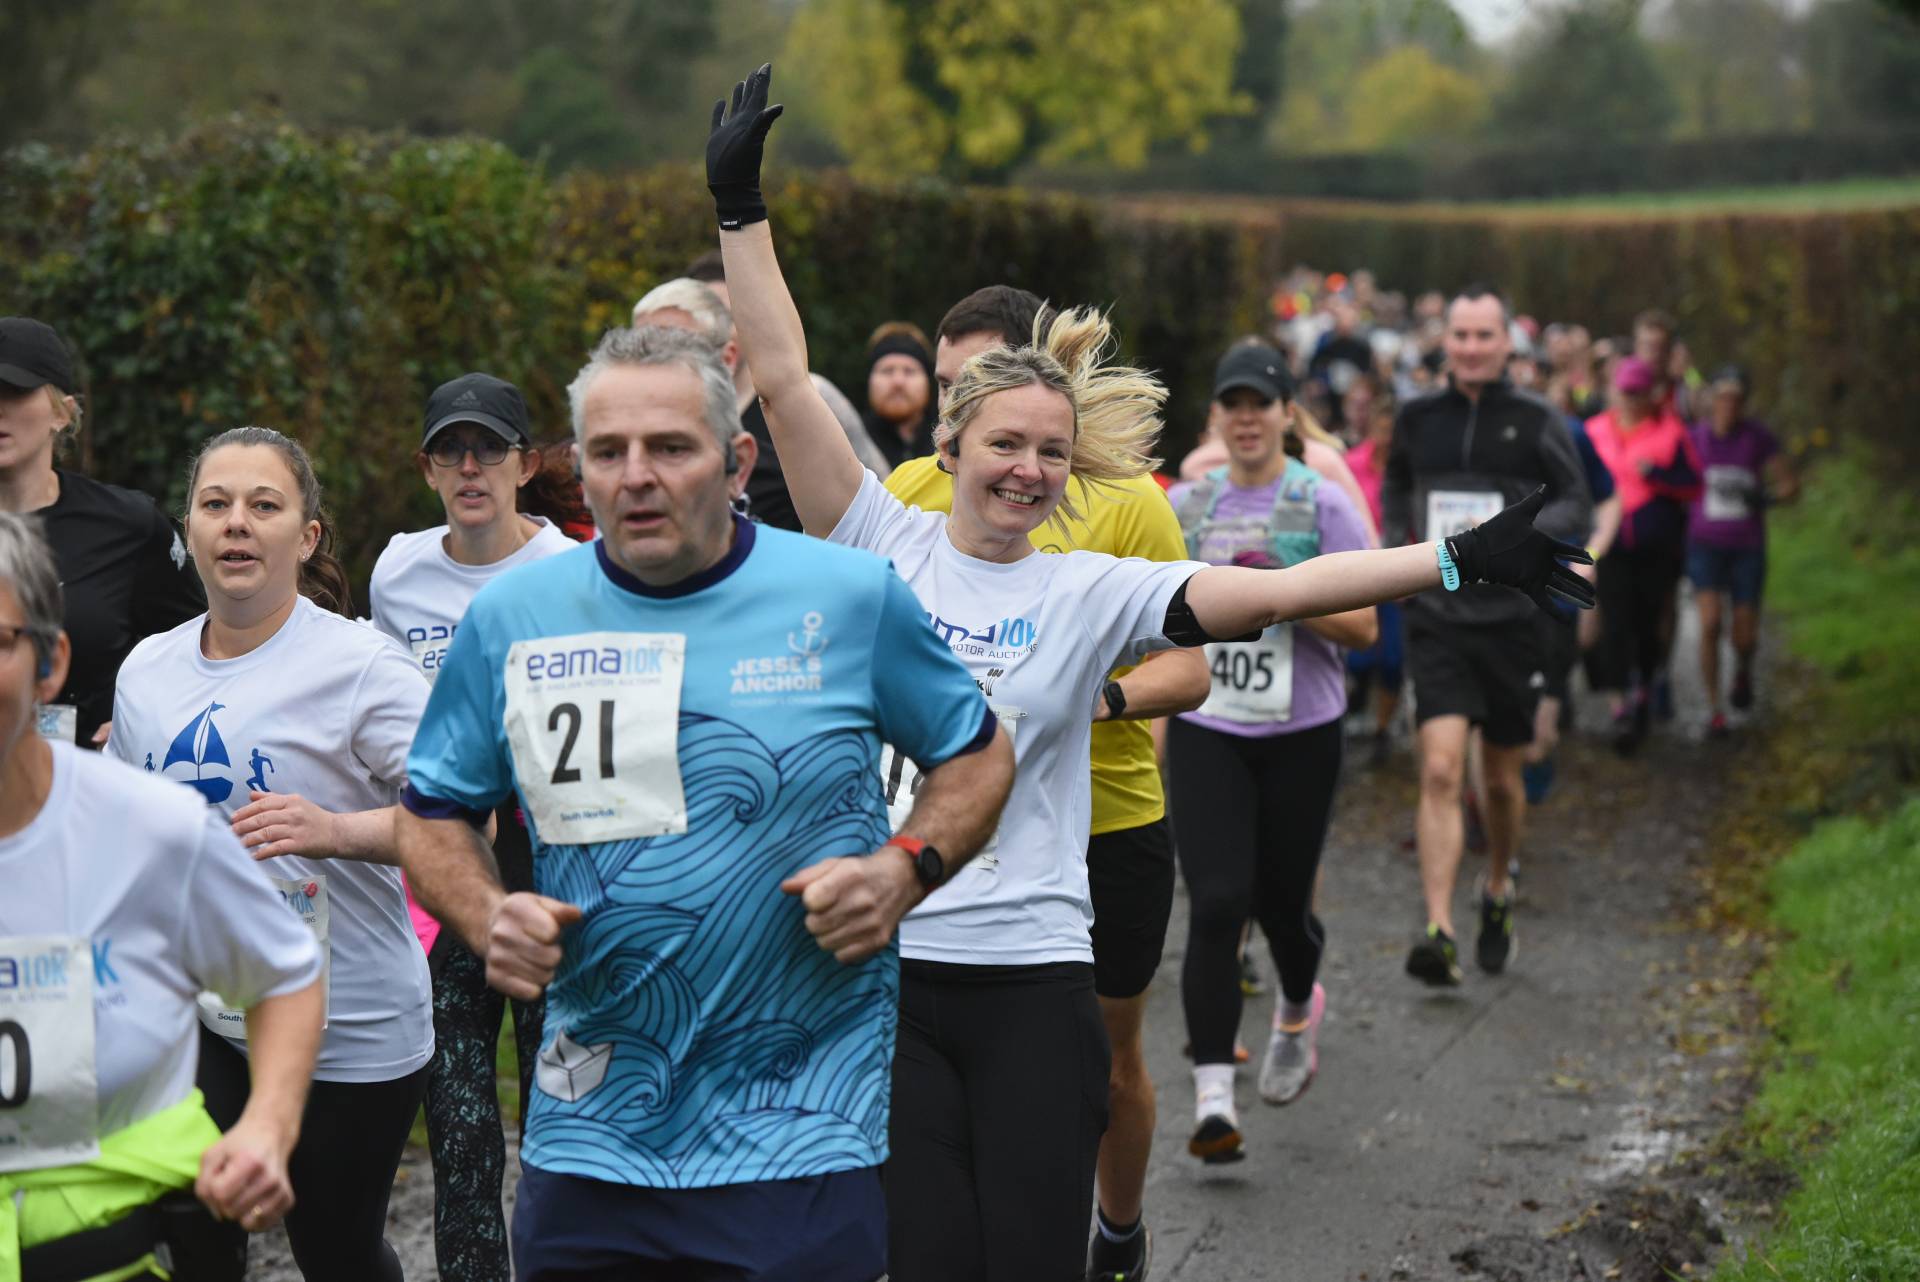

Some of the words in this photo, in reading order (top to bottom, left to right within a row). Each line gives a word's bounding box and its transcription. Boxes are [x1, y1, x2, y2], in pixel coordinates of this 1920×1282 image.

[526, 647, 663, 681] eama10K
[1211, 650, 1274, 691] 405
[731, 675, 822, 694] ANCHOR
[547, 699, 616, 785] 21
[0, 955, 67, 988] a10K
[217, 1013, 242, 1023] South
[0, 1019, 31, 1110] 0
